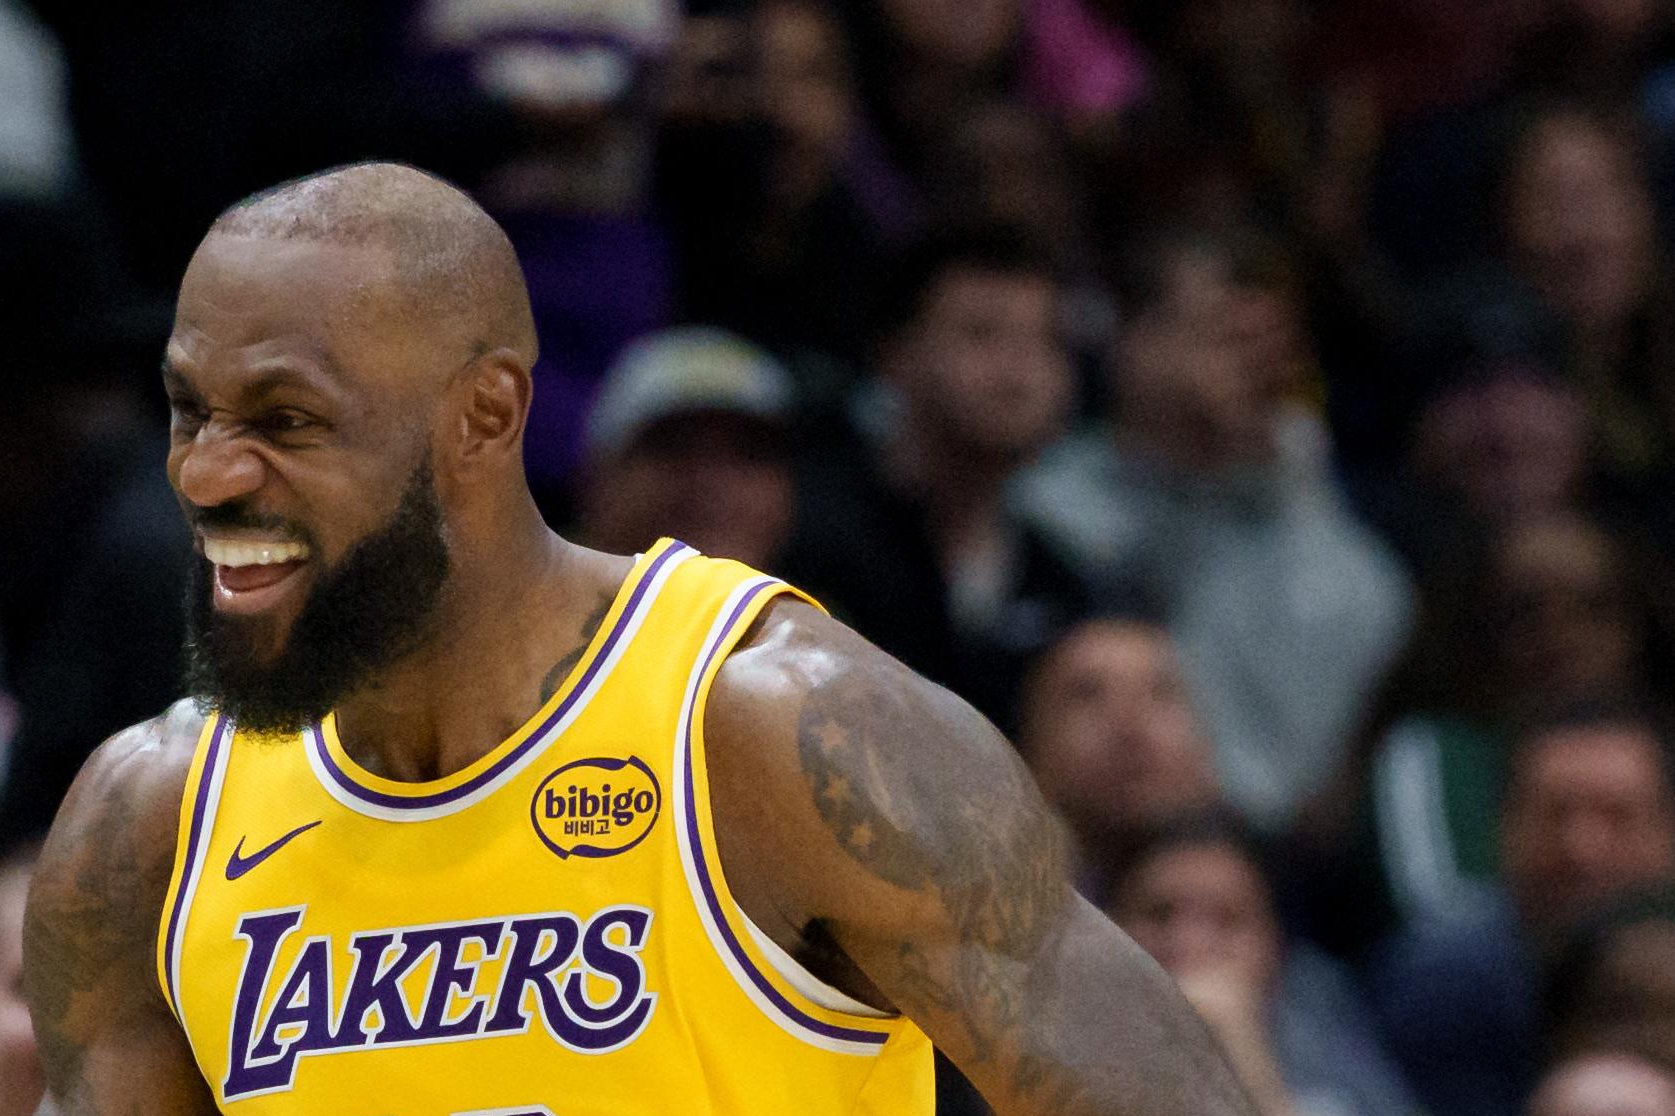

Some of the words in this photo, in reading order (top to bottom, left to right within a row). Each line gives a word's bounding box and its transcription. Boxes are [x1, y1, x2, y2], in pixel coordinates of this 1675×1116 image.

[545, 783, 654, 826] bibigo
[564, 819, 611, 837] 비비고
[222, 904, 659, 1104] LAKERS
